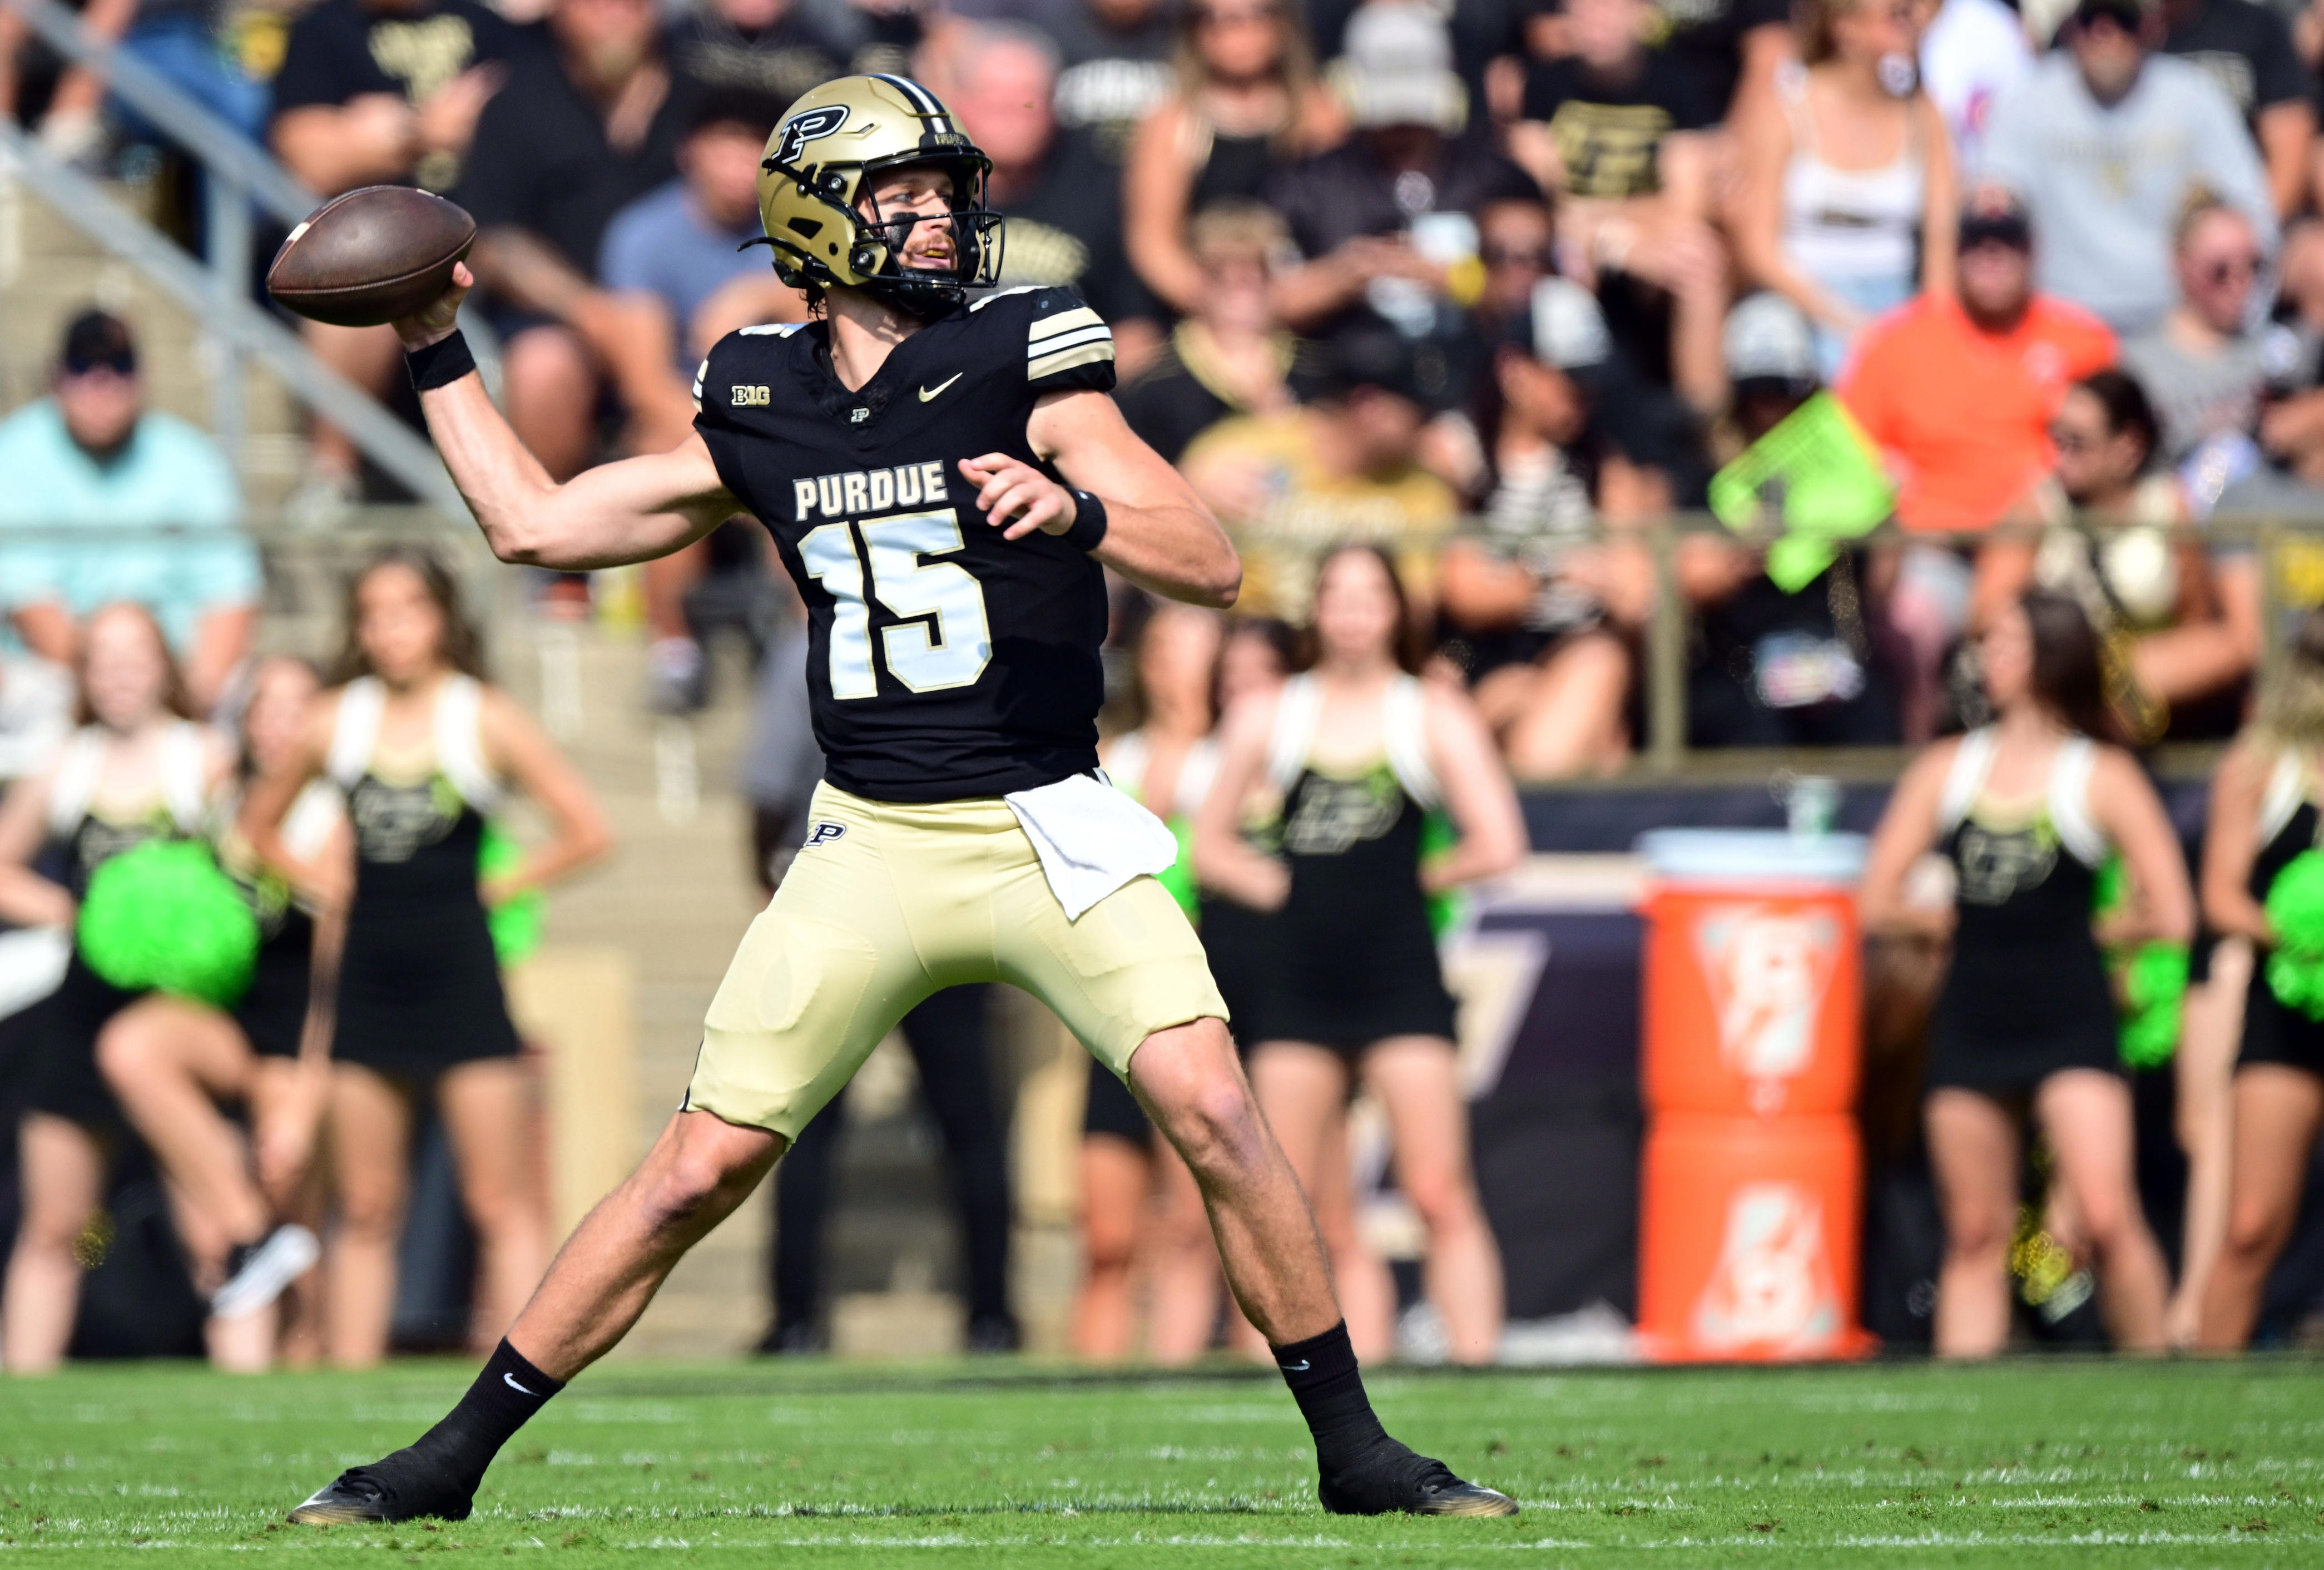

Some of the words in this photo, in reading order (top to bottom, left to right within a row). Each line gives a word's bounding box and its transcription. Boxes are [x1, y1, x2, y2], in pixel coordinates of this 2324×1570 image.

[768, 104, 851, 165] P
[851, 407, 870, 423] P
[792, 460, 948, 522] PURDUE
[797, 508, 993, 700] 15
[806, 821, 847, 846] P
